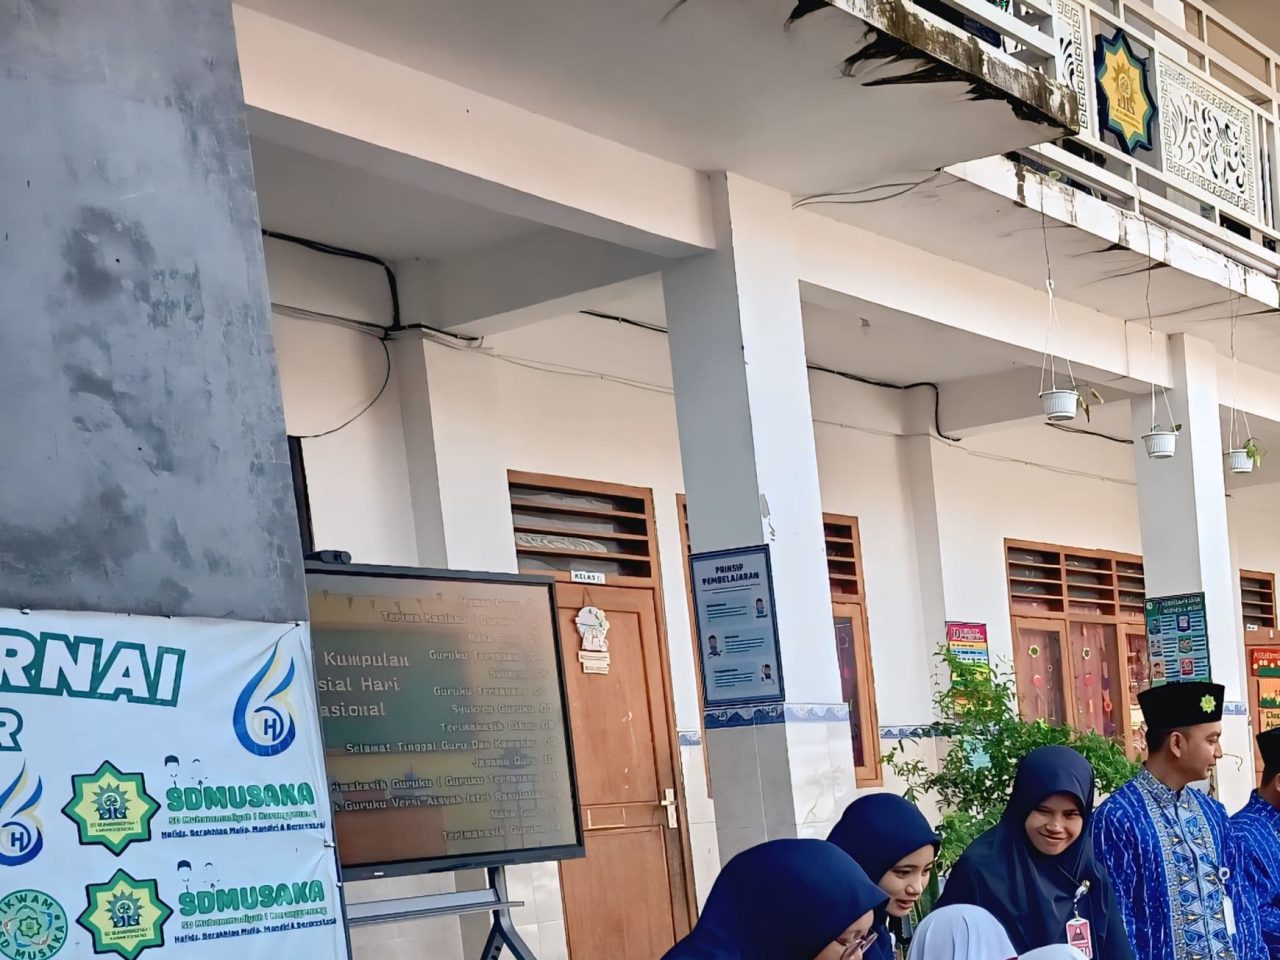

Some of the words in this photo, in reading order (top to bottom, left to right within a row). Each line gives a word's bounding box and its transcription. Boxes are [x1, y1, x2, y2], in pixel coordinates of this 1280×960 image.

[0, 628, 186, 707] RNAI
[324, 651, 410, 668] Kumpulan
[318, 676, 353, 691] sial
[361, 676, 401, 691] Hari
[320, 702, 386, 717] asional
[392, 778, 432, 789] Guruku
[166, 782, 315, 812] SDMUSAKA
[344, 800, 386, 811] Guruku
[0, 894, 53, 914] IKWAM
[179, 879, 325, 916] SDMUSAKA
[15, 925, 64, 960] MUSAKA
